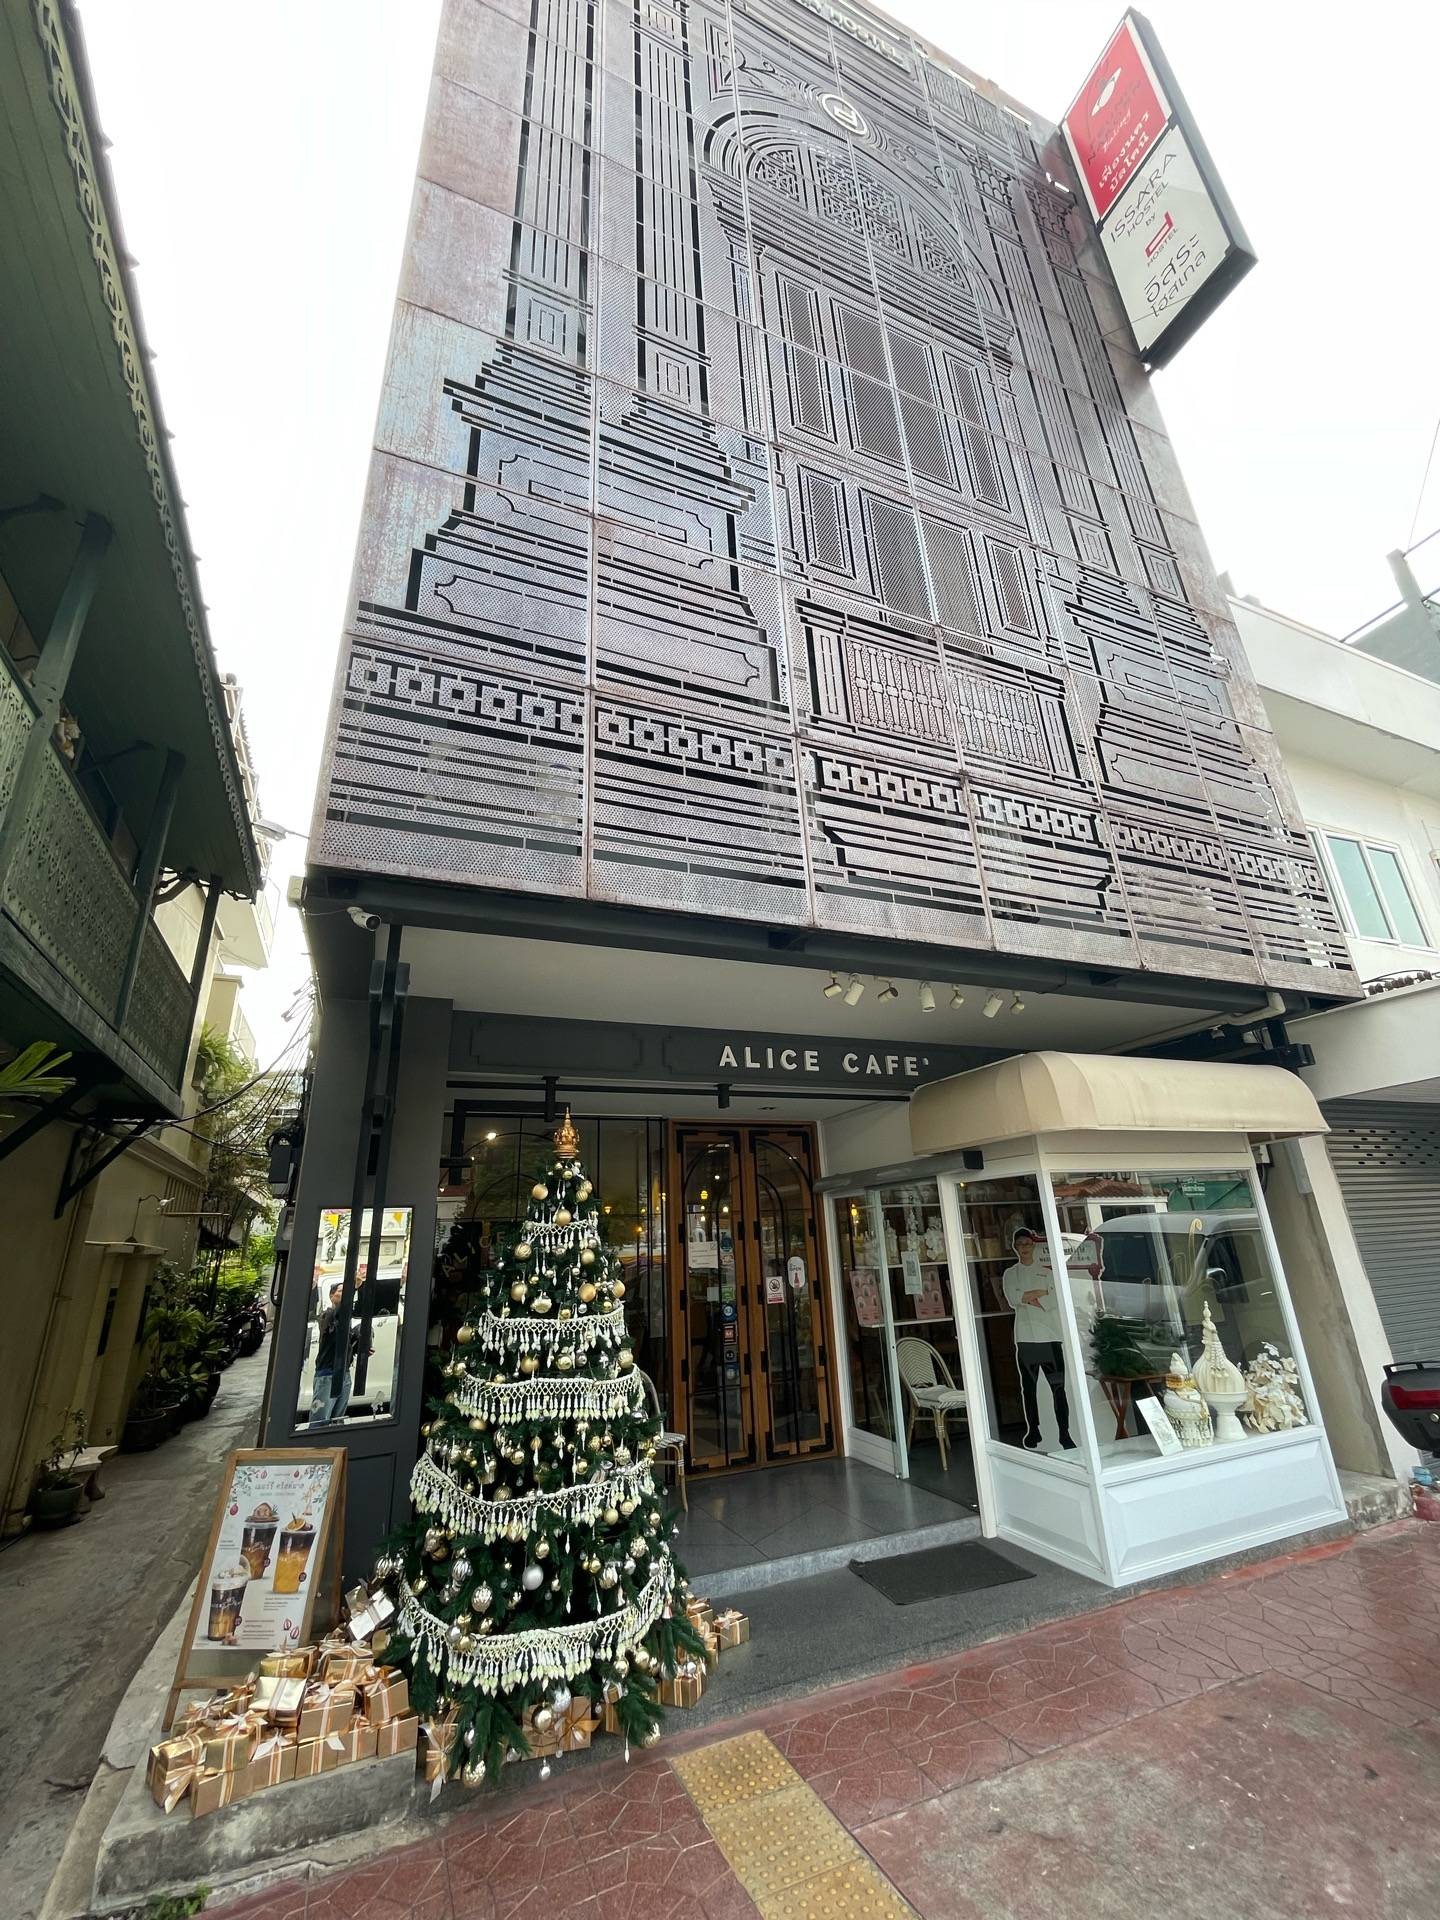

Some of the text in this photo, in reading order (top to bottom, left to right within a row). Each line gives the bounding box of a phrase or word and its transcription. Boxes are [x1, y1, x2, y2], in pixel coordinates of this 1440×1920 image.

[1110, 153, 1177, 243] ISSARA
[1126, 181, 1169, 238] HOSTEL
[1146, 228, 1178, 267] HOSTEL
[719, 1045, 919, 1076] ALICE CAFE
